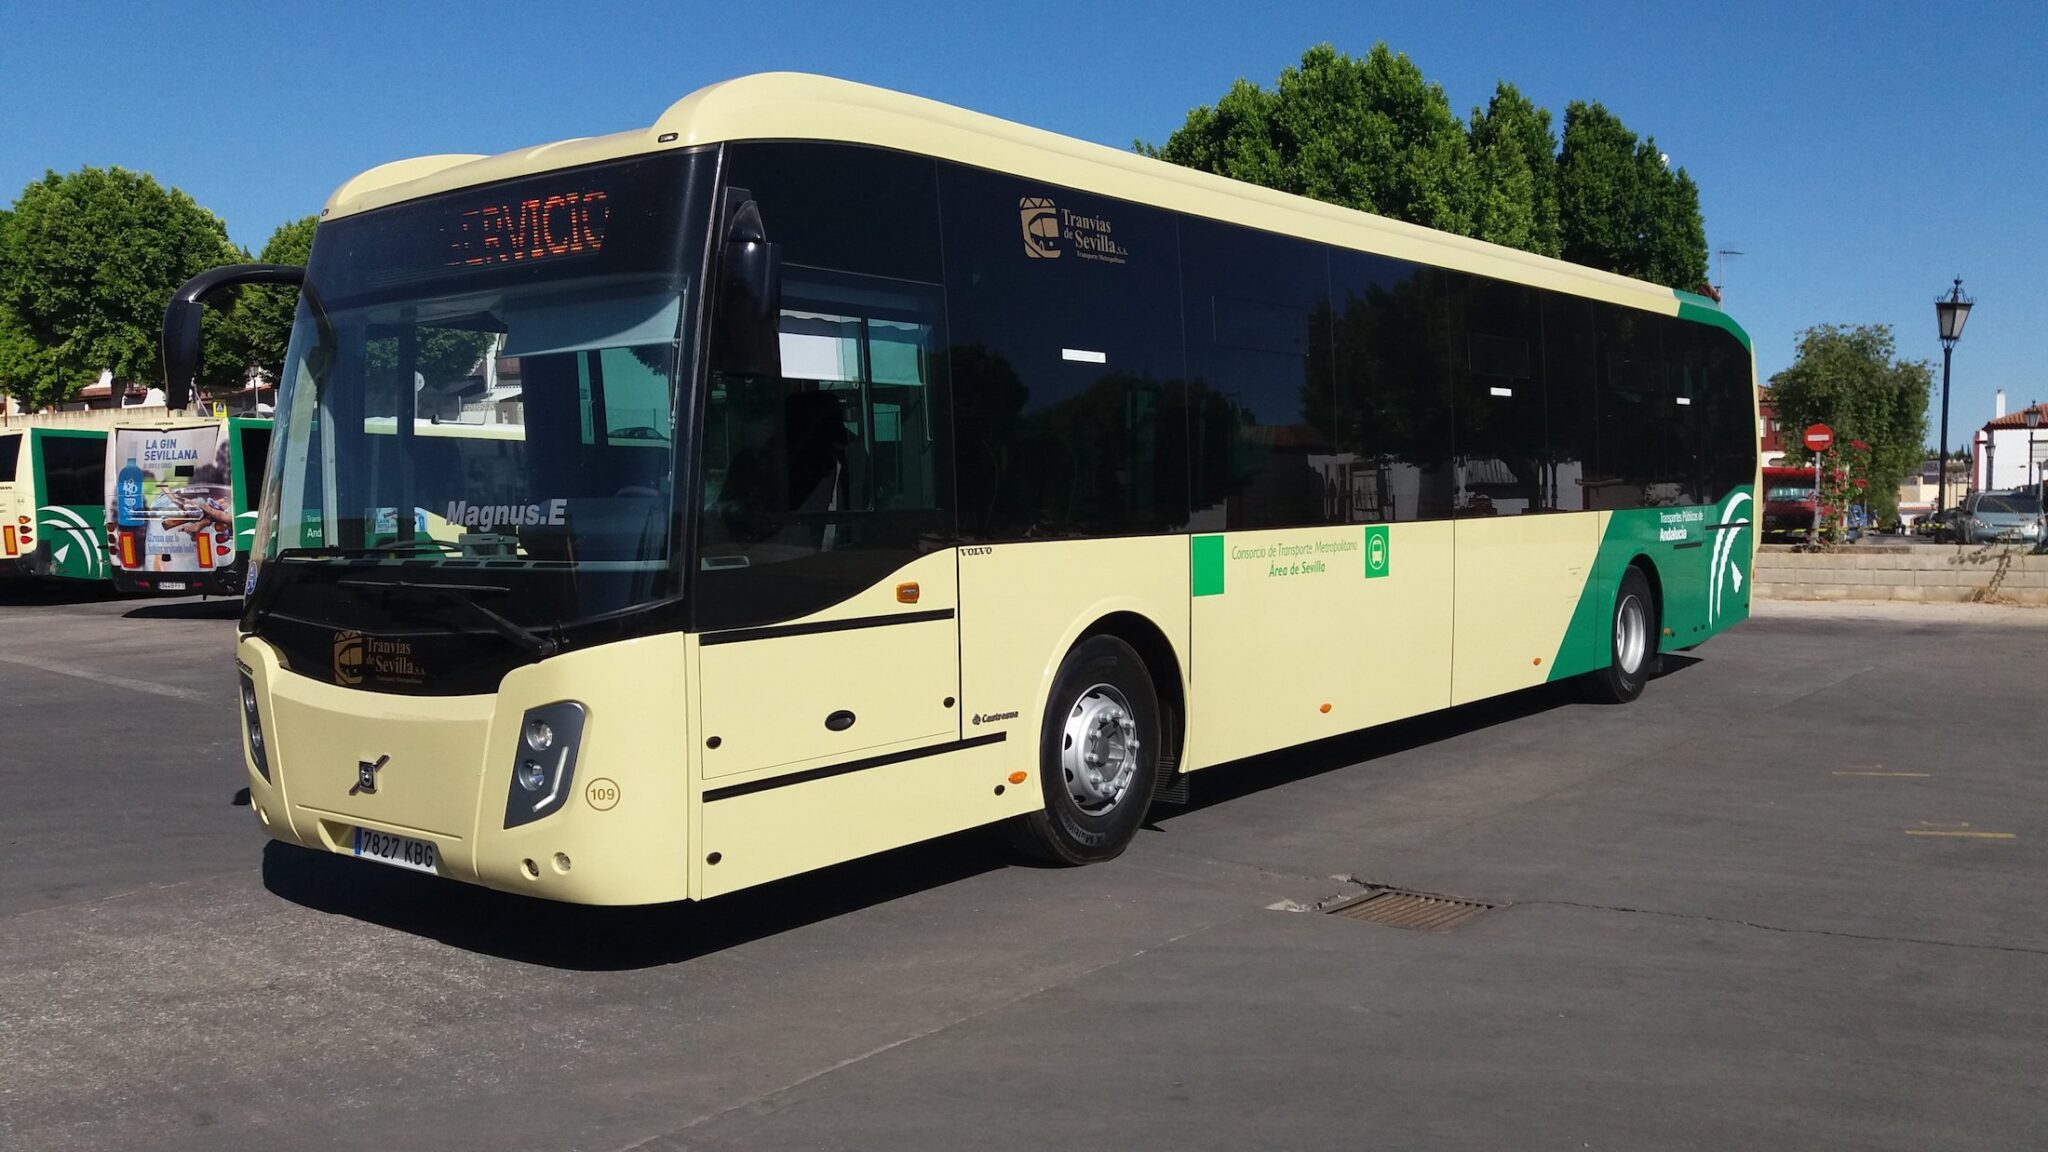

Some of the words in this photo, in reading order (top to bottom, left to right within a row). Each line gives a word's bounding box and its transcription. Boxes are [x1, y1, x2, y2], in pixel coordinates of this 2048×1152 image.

[1061, 208, 1112, 233] Tranvías
[1063, 227, 1074, 239] de
[145, 439, 157, 450] LA
[160, 438, 177, 449] GIN
[144, 449, 198, 461] SEVILLANA
[446, 498, 568, 532] Magnus.E
[959, 546, 993, 557] VOLVO
[1231, 545, 1266, 560] Consorcio
[1267, 545, 1277, 558] de
[1278, 543, 1313, 559] Transporte
[1314, 539, 1358, 556] Metropolitano
[1269, 560, 1288, 577] Área
[1289, 562, 1299, 575] de
[1301, 560, 1326, 574] Sevilla
[366, 637, 411, 654] Tranvías
[590, 787, 615, 801] 109
[363, 831, 400, 860] 7827
[404, 840, 433, 868] KBG
